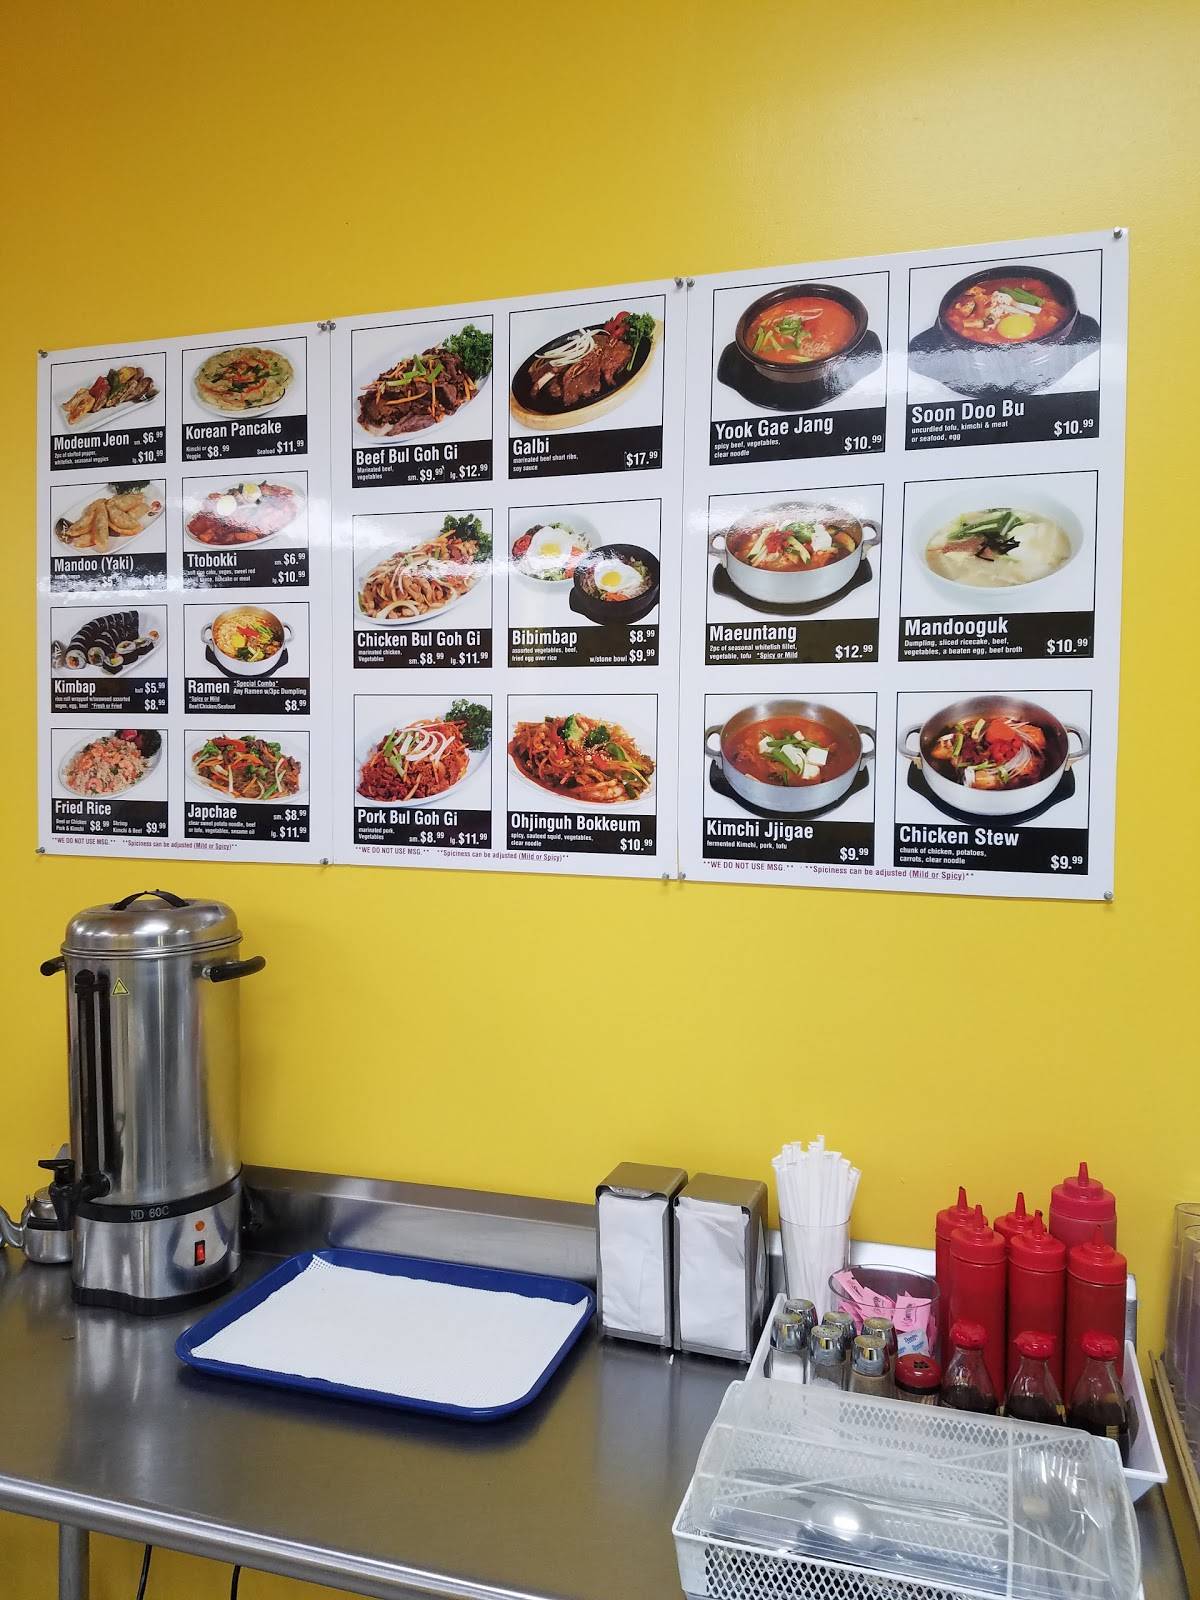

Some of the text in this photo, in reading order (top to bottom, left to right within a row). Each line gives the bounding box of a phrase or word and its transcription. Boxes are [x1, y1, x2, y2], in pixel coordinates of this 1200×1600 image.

[911, 399, 1025, 424] Soon Doo Bu
[186, 420, 282, 440] Korean Pancake
[715, 416, 833, 440] Yook Gae Jang
[911, 425, 943, 434] uncurdled
[54, 432, 130, 450] Modeum Jeon
[513, 437, 549, 455] Galbi
[714, 443, 729, 451] spicy
[356, 444, 458, 465] Beef Bul Goh Gi
[730, 449, 750, 457] noodle
[55, 555, 134, 573] Mandoo (Yaki)
[187, 552, 237, 568] Ttobokki
[710, 625, 797, 643] Maeuntang
[905, 617, 1008, 637] Mandooguk
[357, 631, 480, 647] Chicken Bul Goh Gi
[512, 630, 577, 647] Bibimbap
[904, 640, 937, 648] Dumpling,
[55, 680, 96, 696] Kimbap
[188, 680, 230, 694] Ramen
[55, 801, 111, 815] Fried Rice
[187, 804, 237, 821] Japchae
[357, 809, 458, 826] Pork Bul Goh Gi
[511, 813, 641, 833] Ohjinguh Bokkeum
[706, 820, 814, 841] Kimchi Jjigae
[899, 826, 1019, 846] Chicken Stew
[875, 868, 906, 879] adjusted
[909, 869, 929, 880] (Mild
